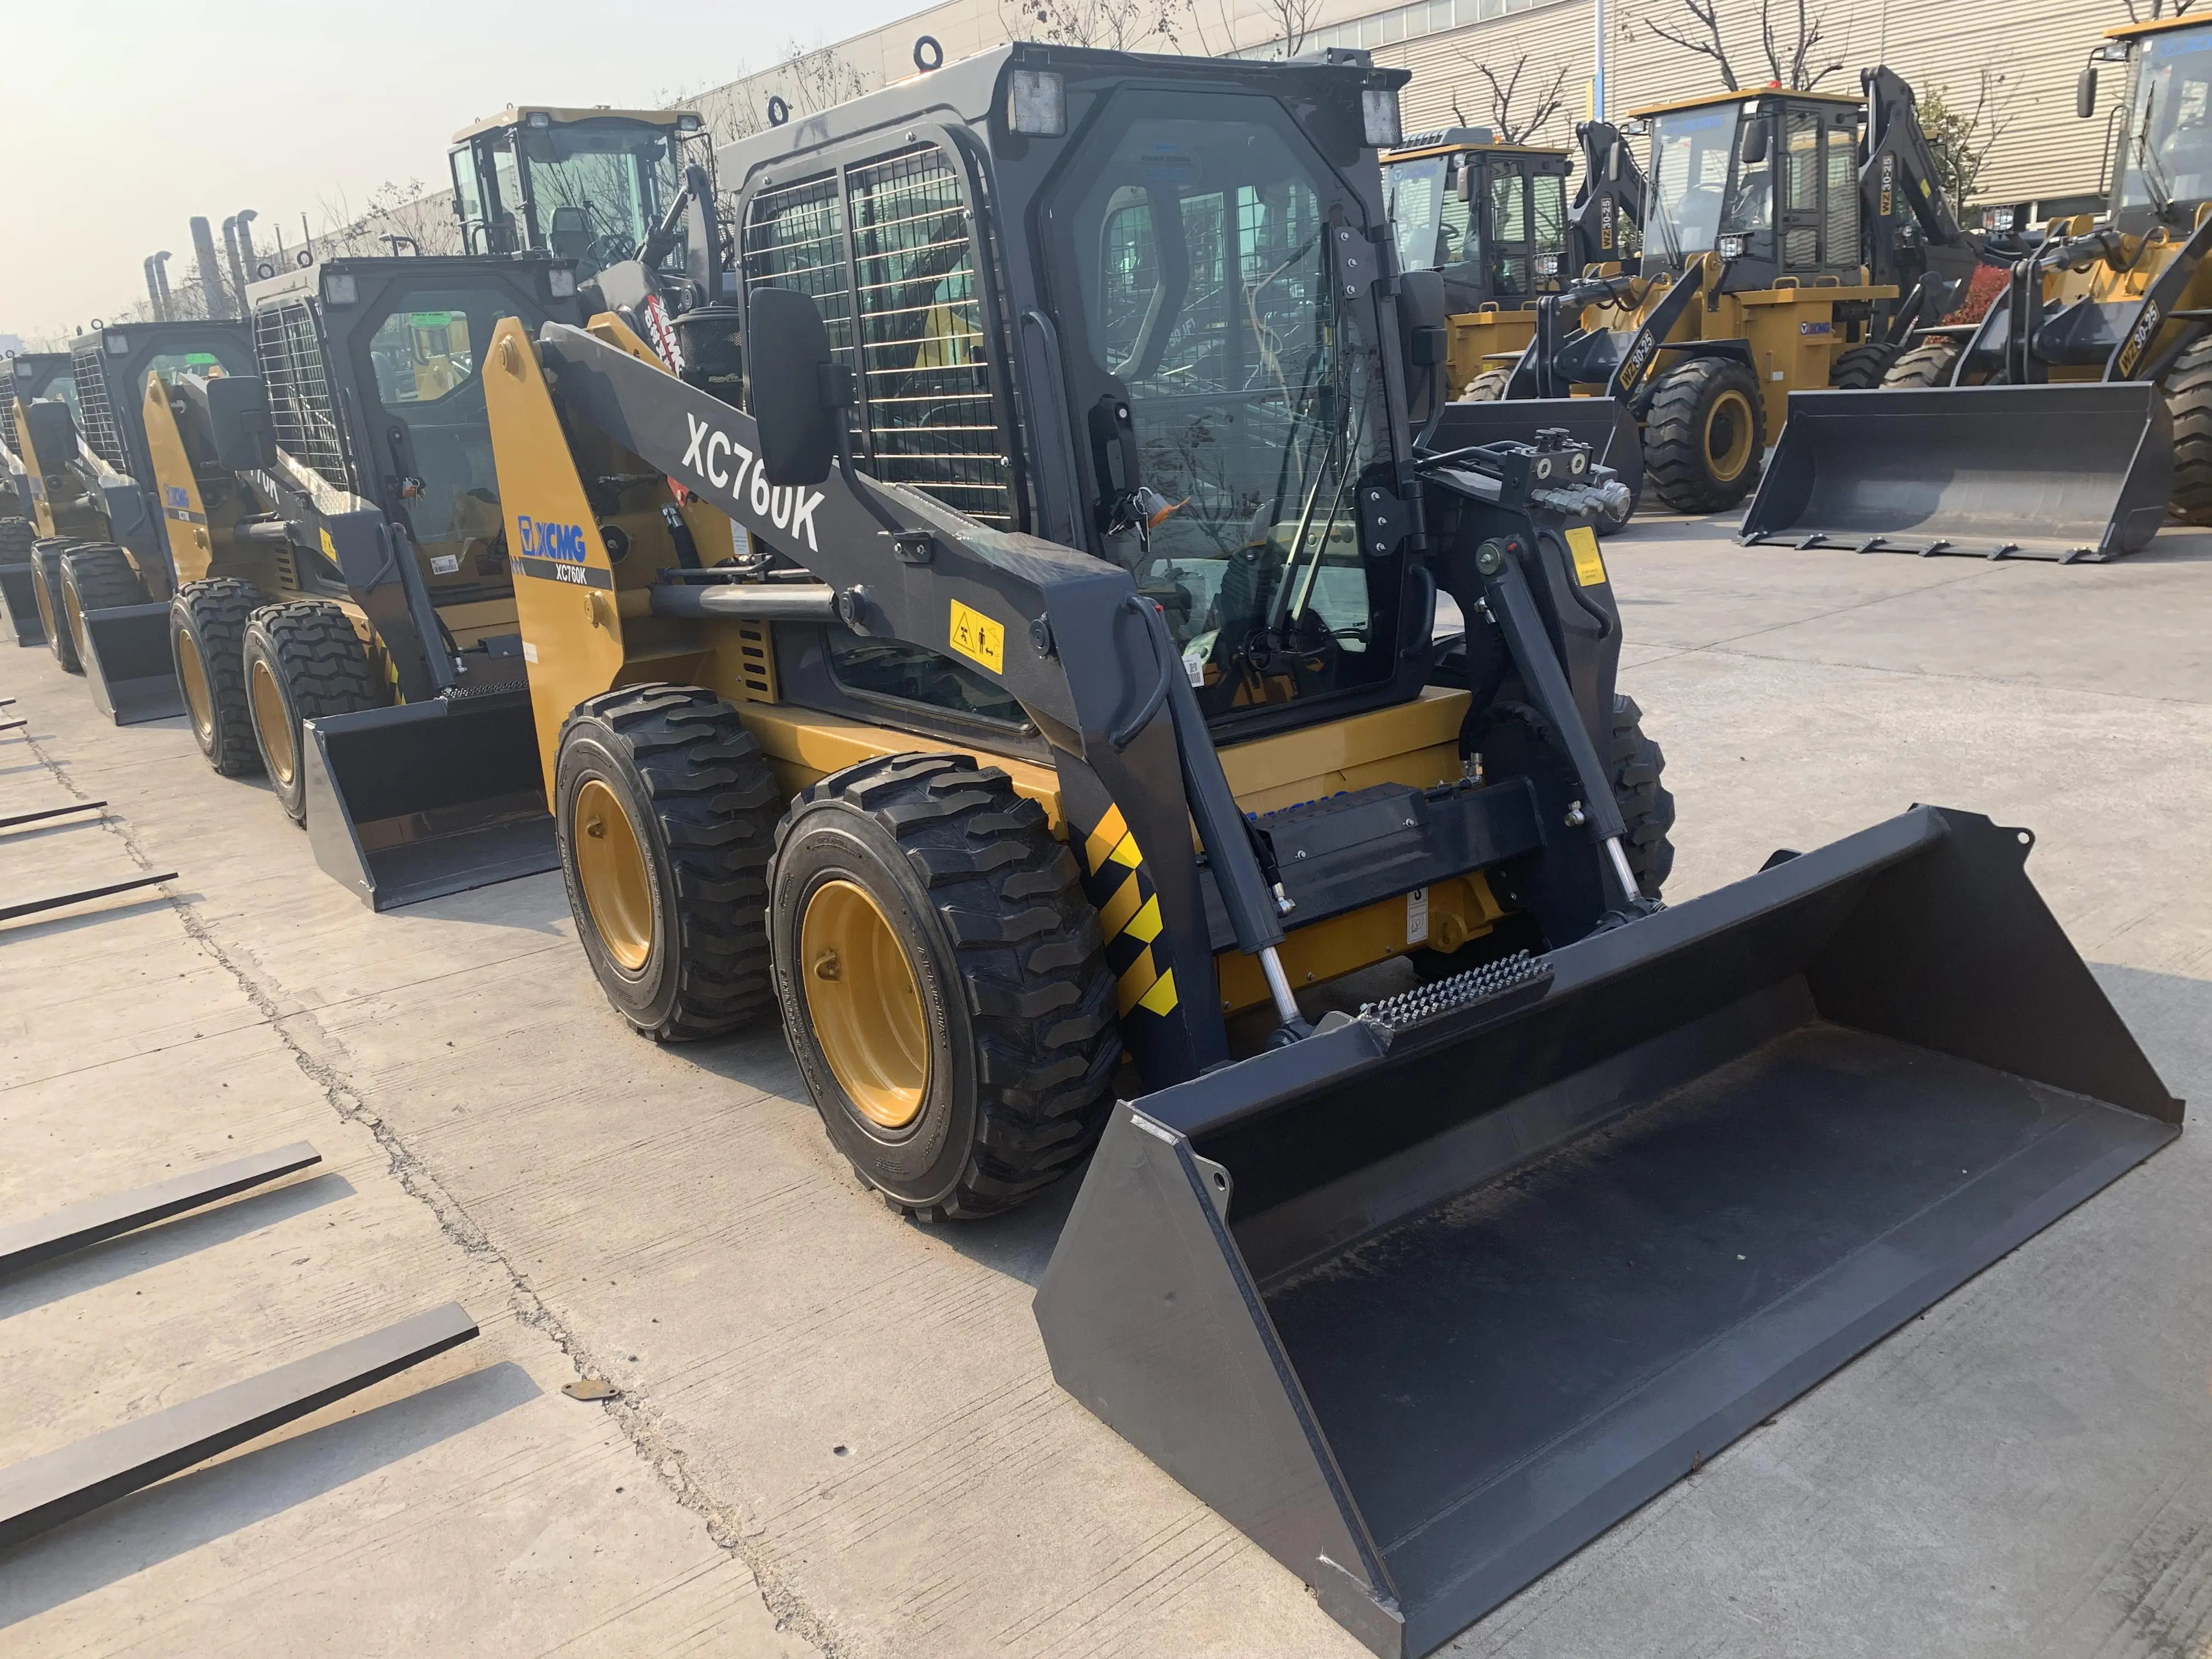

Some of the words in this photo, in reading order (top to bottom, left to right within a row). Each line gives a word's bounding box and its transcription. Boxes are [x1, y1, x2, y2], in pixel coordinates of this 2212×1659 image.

[681, 412, 825, 552] XC760K
[533, 522, 586, 563] XCMG
[555, 563, 587, 585] XC760K
